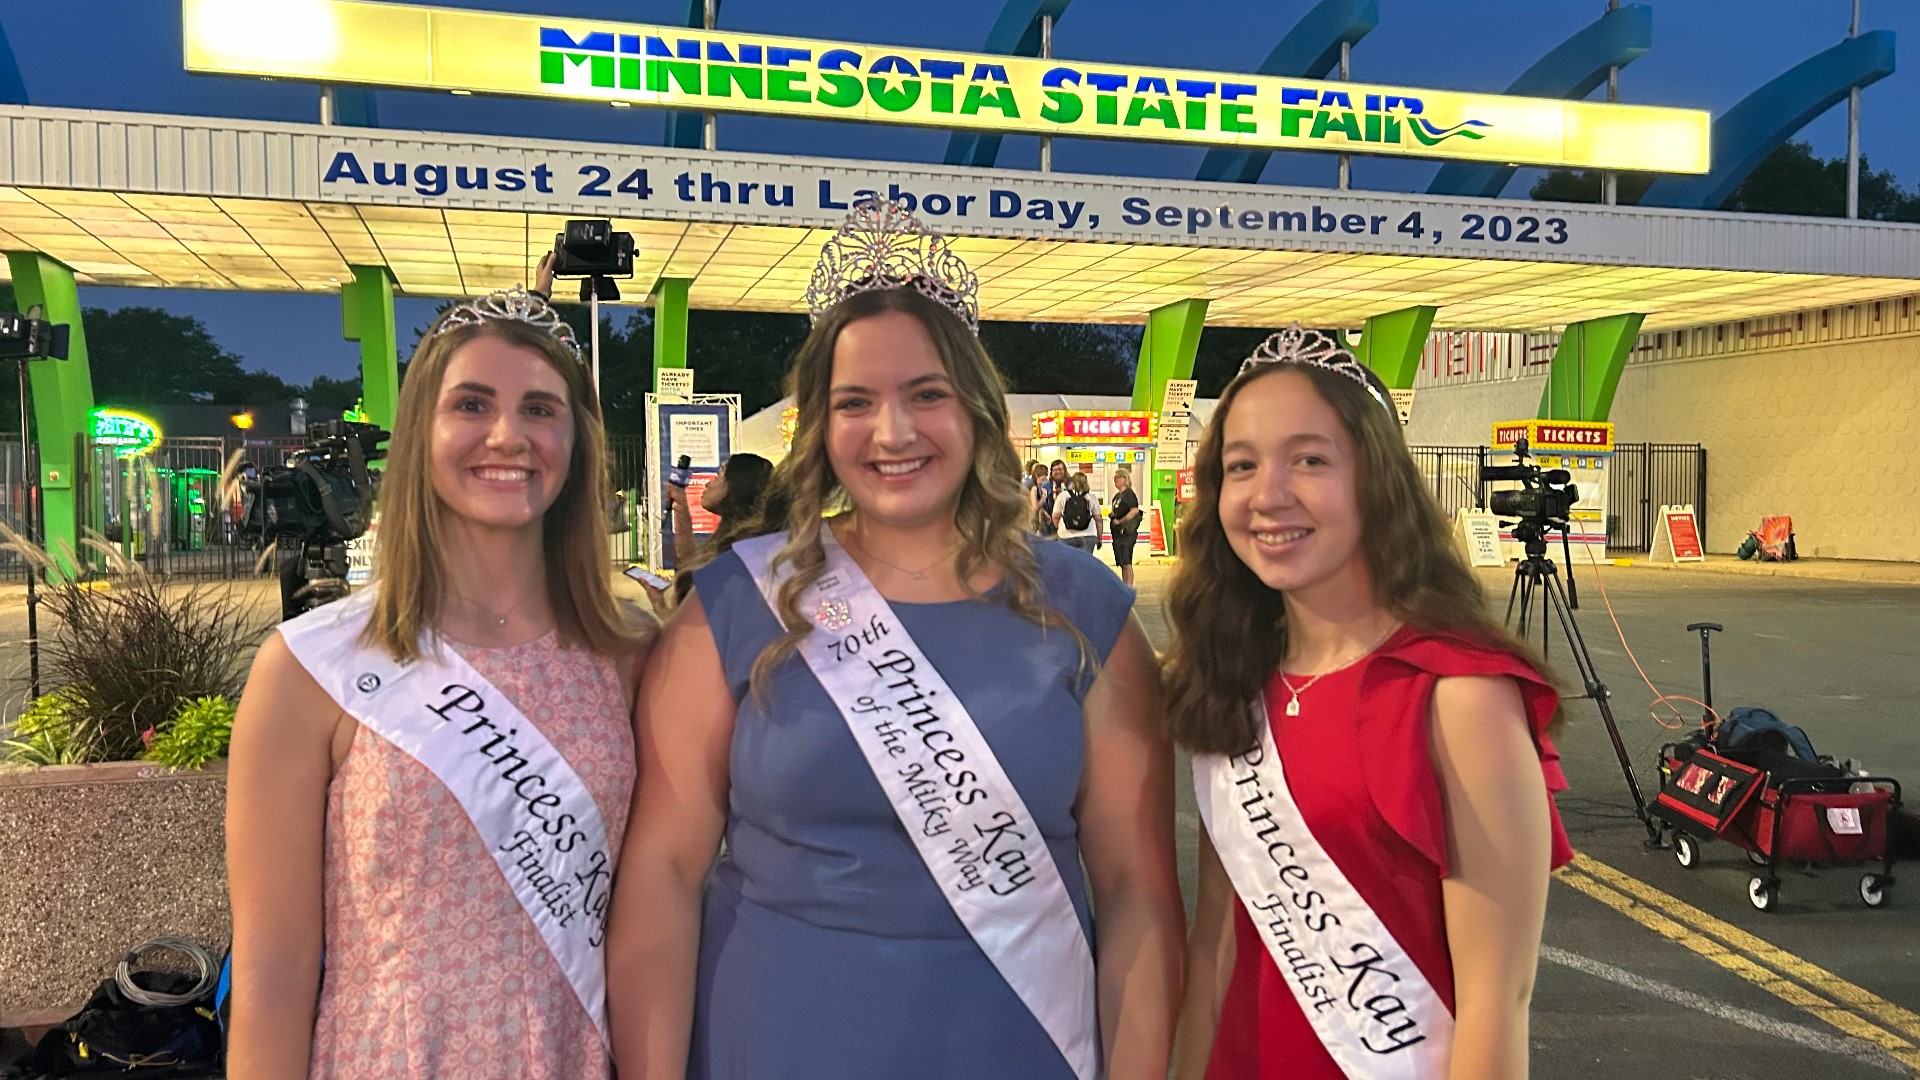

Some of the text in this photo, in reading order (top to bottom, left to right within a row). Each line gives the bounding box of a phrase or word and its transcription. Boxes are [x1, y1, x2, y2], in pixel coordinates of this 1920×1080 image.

[540, 27, 1450, 145] MINNESOTA STATE FAIR
[322, 152, 1568, 244] August 24 thru Labor Day, September 4, 2023
[1073, 420, 1141, 435] TICKETS
[1499, 429, 1528, 442] TICKETS
[1543, 429, 1601, 443] TICKETS
[346, 539, 374, 551] EXIT
[827, 614, 890, 662] 70th
[426, 684, 610, 948] Princess Kay
[851, 696, 985, 891] of the Milky Way
[868, 649, 1037, 896] Princess Kay
[500, 830, 577, 928] Finalist
[1229, 737, 1427, 1056] Princess Kay
[1253, 893, 1338, 1014] Finalist
